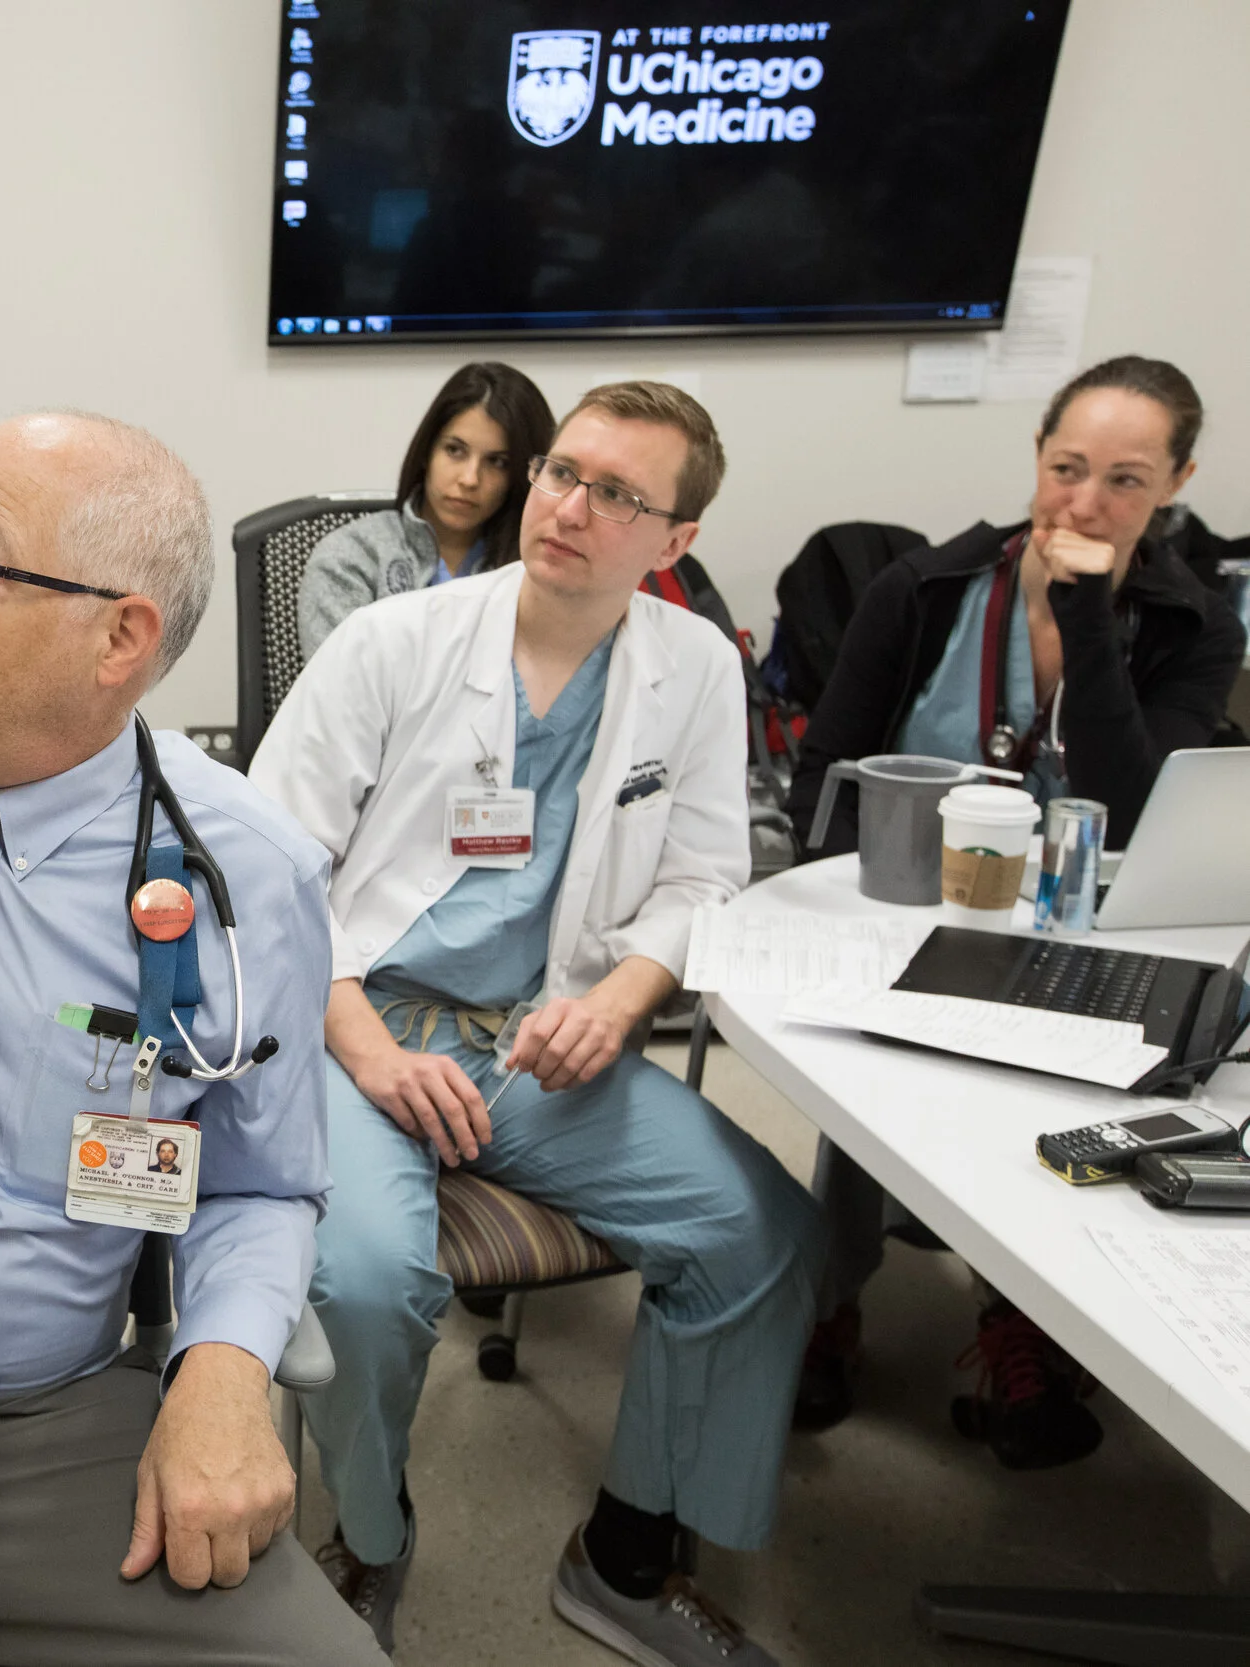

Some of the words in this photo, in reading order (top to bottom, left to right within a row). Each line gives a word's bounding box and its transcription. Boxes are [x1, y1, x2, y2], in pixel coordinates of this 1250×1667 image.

[612, 28, 640, 46] AT
[650, 27, 692, 46] THE
[700, 22, 830, 44] FOREFRONT
[607, 50, 824, 99] UChicago
[600, 97, 816, 146] Medicine
[79, 1167, 110, 1176] MICHAEL
[79, 1175, 123, 1186] ANESTHESIA
